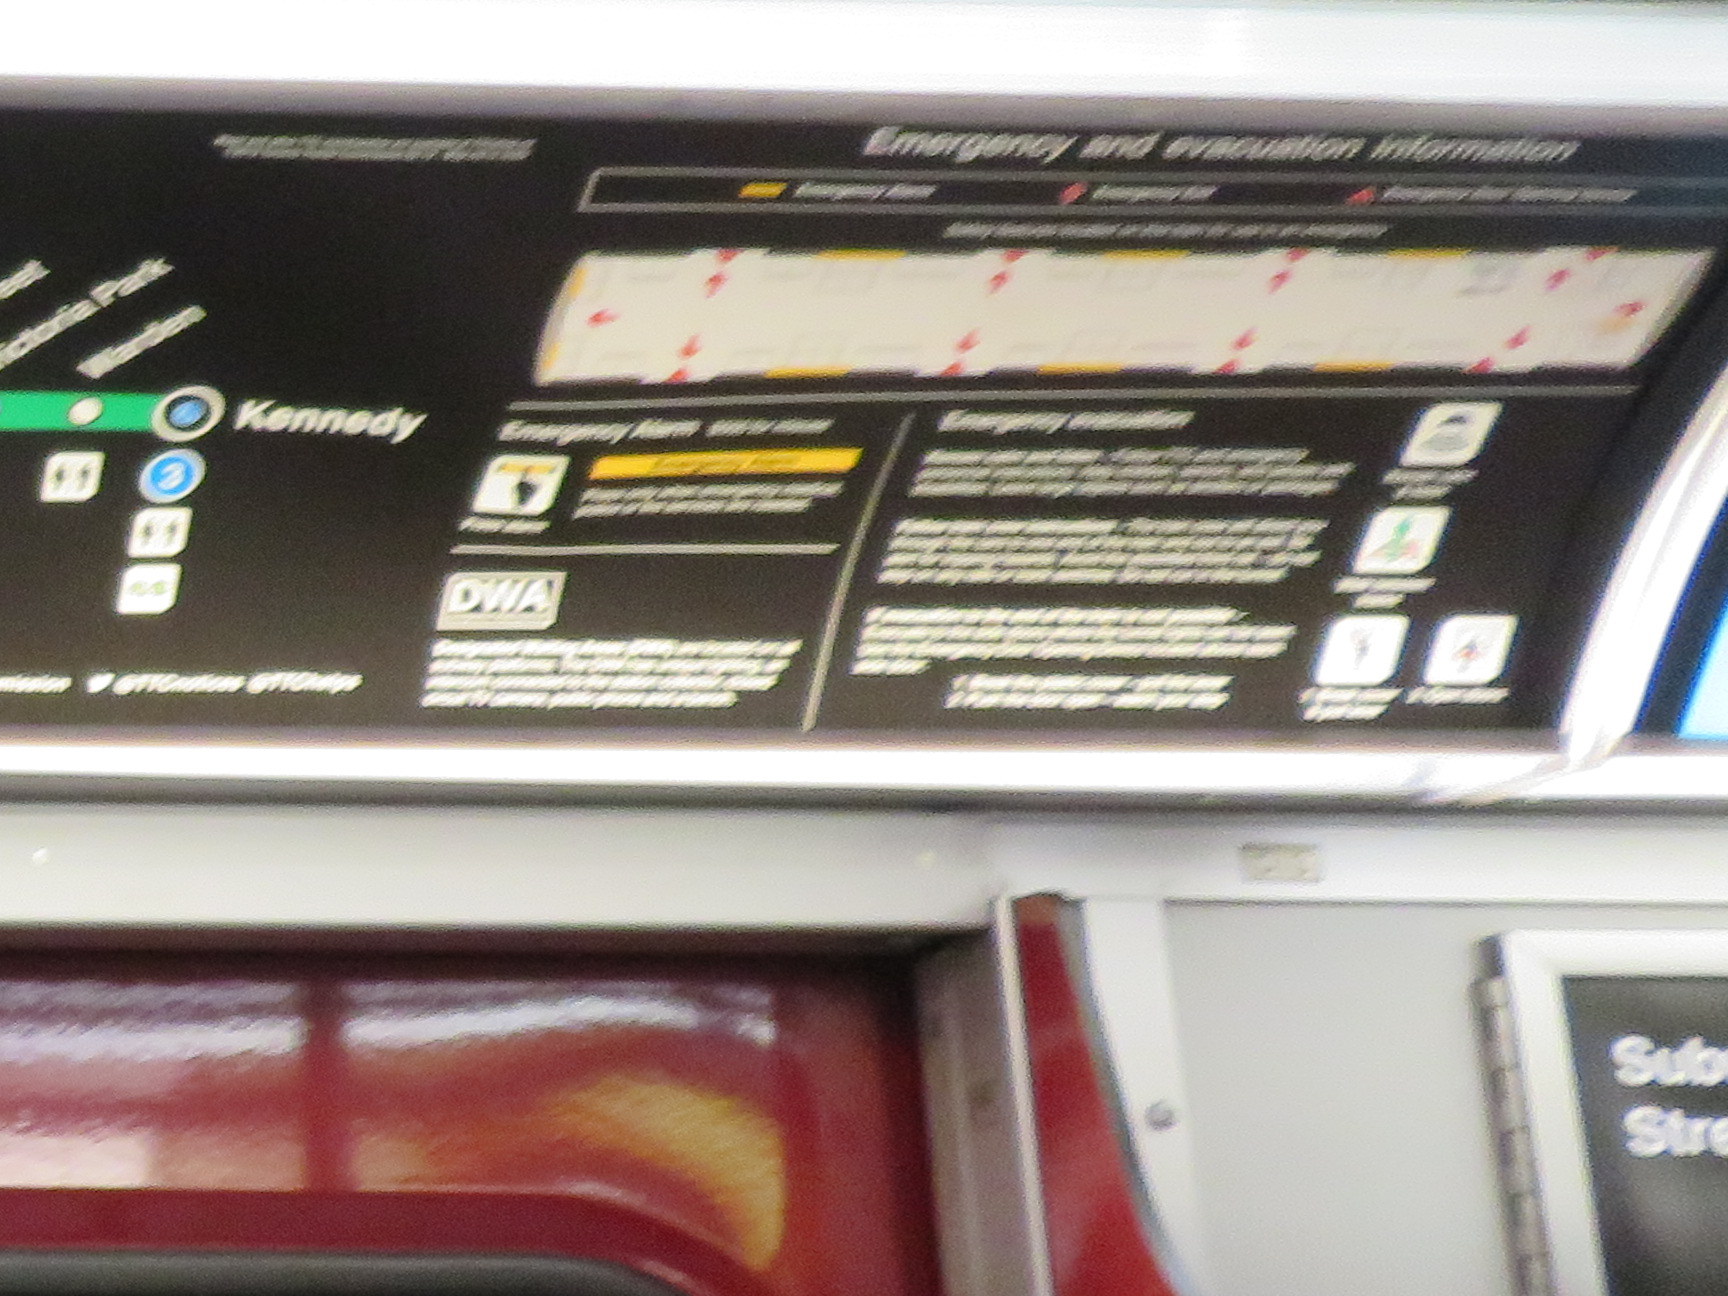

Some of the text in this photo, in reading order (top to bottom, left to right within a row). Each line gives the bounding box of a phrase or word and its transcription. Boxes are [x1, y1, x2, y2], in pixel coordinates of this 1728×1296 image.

[862, 127, 1580, 166] Emergency and evacuation information
[235, 399, 428, 446] Kennedy
[446, 579, 552, 615] DWA
[1608, 1034, 1728, 1087] Sub
